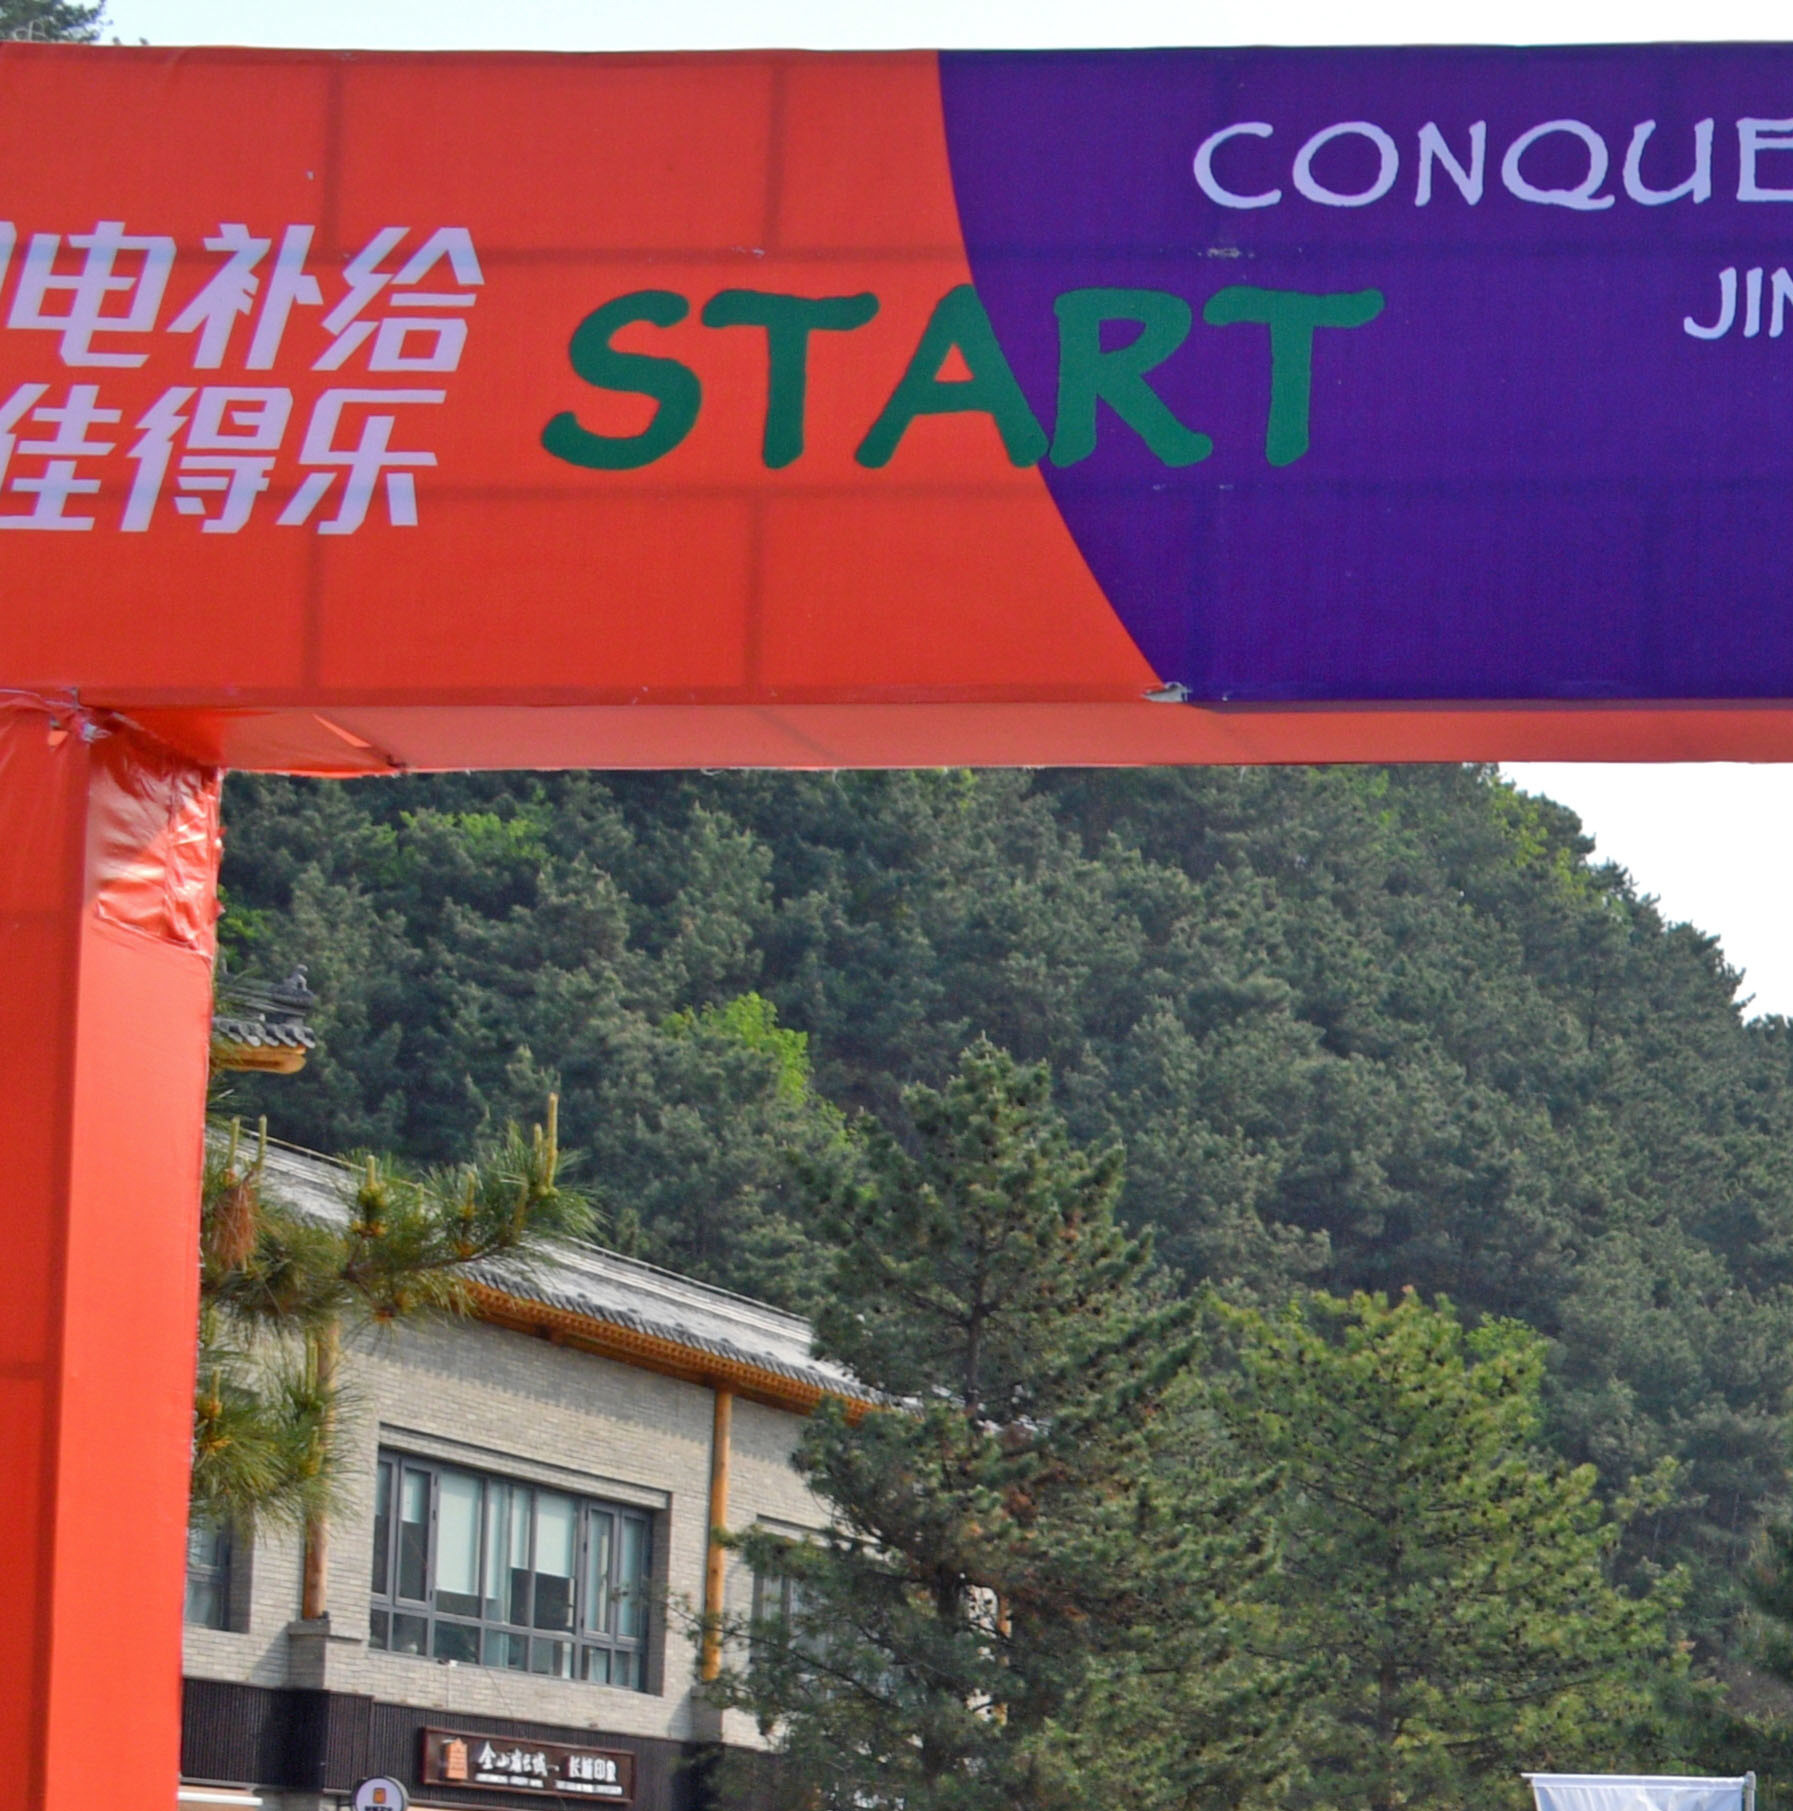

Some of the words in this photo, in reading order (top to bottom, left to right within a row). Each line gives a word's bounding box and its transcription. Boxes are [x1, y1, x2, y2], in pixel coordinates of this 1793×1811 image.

[0, 220, 485, 372] 电补给
[541, 288, 1384, 468] START
[0, 384, 437, 535] 佳得乐
